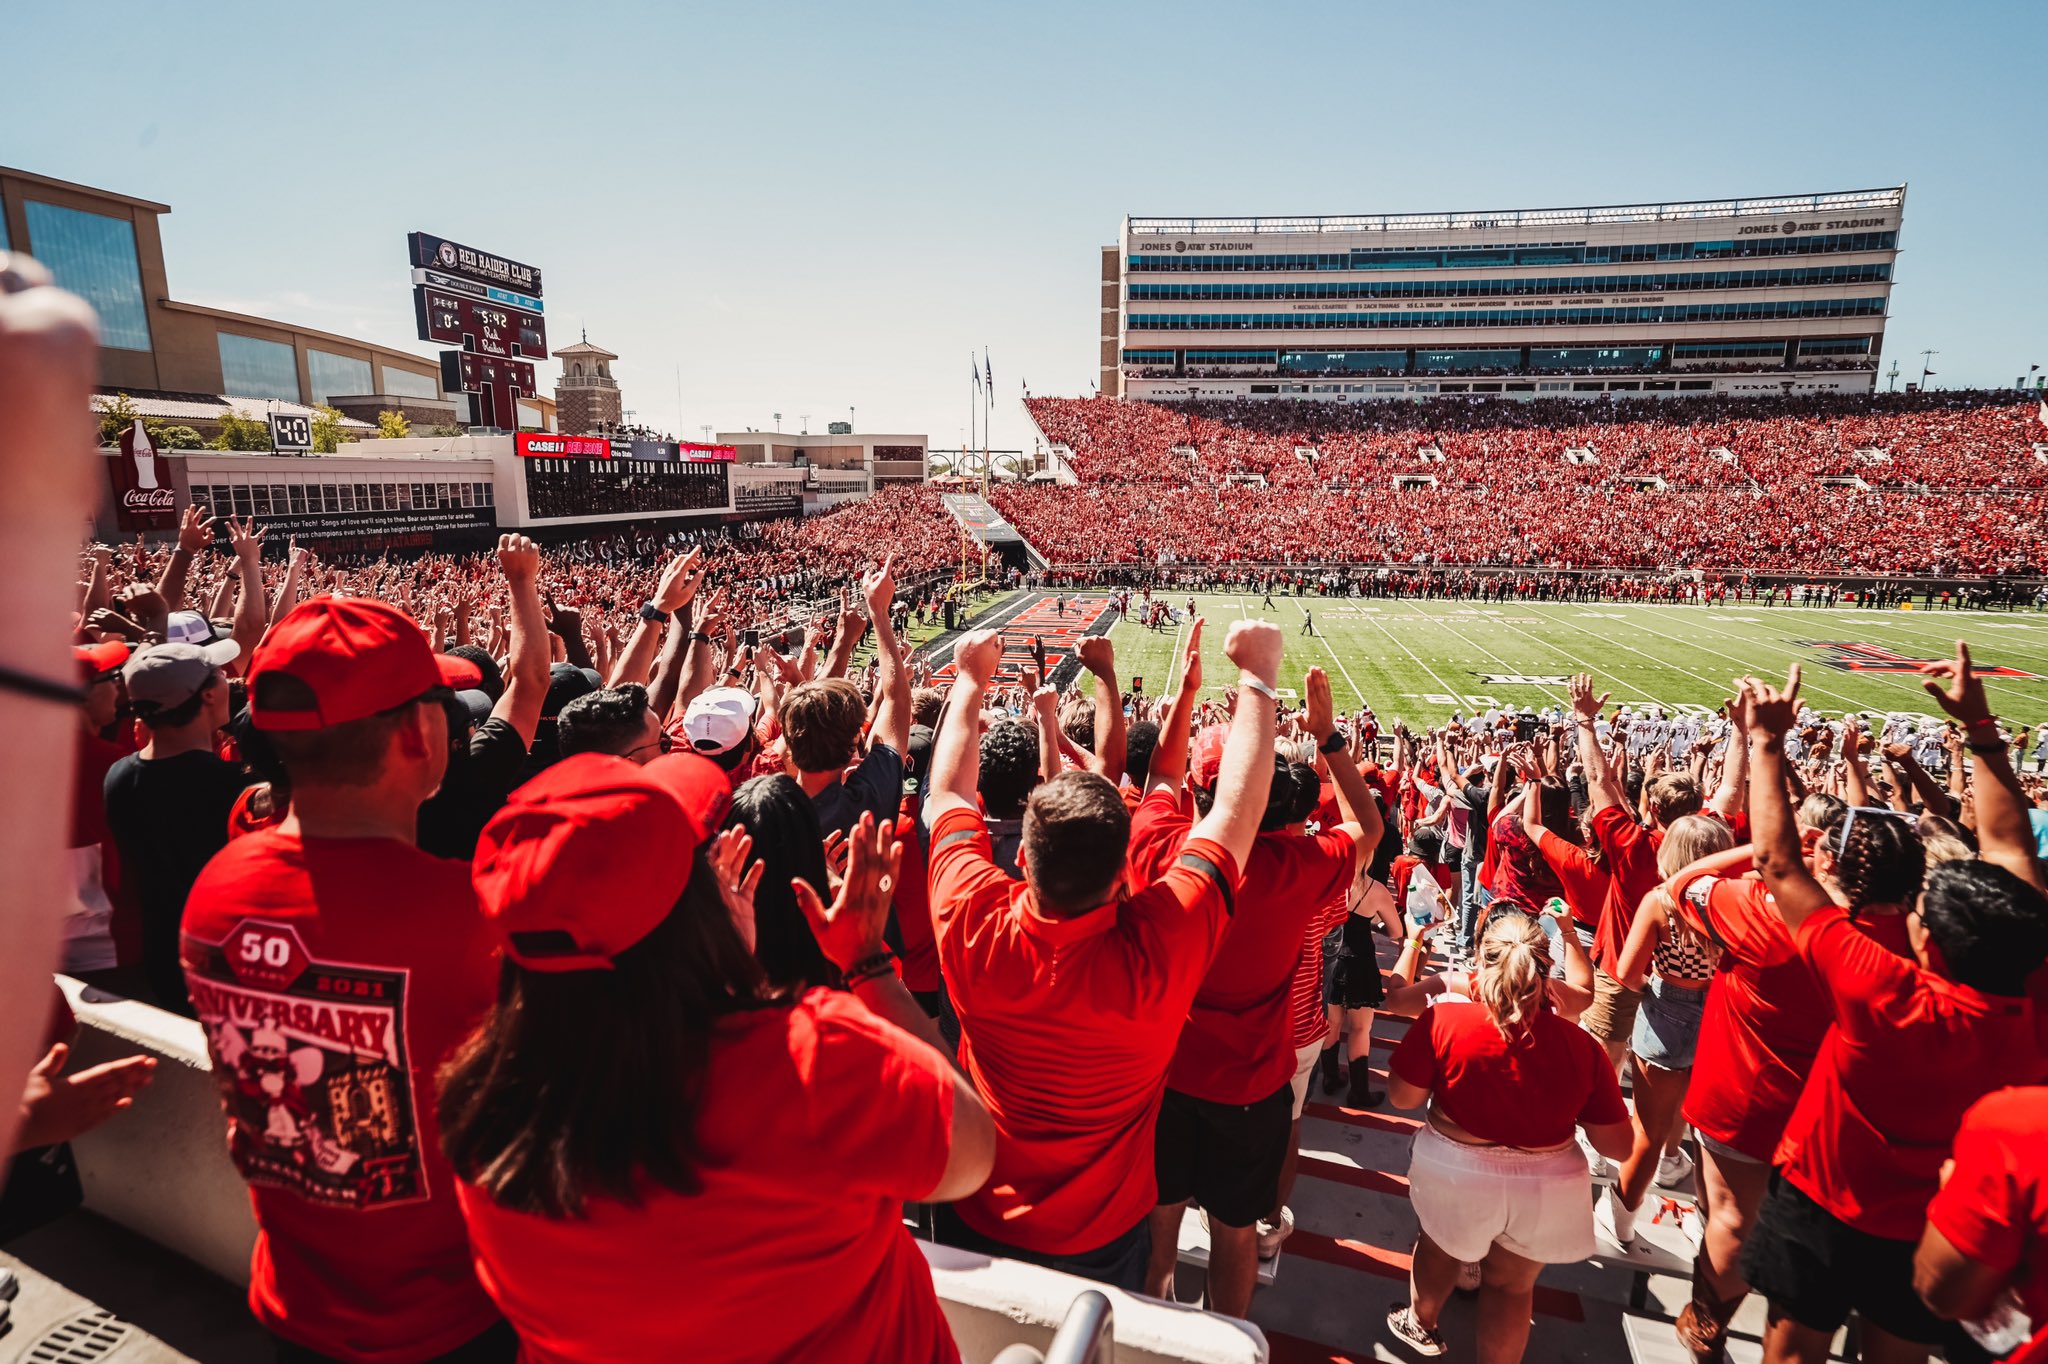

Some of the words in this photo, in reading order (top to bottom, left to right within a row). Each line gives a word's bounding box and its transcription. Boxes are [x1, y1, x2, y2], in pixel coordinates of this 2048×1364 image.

[1737, 225, 1778, 235] JONES
[1797, 222, 1823, 231] AT&T
[1826, 218, 1885, 230] STADIUM
[1140, 243, 1172, 251] JONES
[1187, 243, 1206, 251] AT&T
[1209, 243, 1253, 251] STADIUM
[458, 248, 477, 264] RED
[478, 254, 510, 276] RAIDER
[510, 265, 532, 282] CLUB
[450, 280, 469, 290] DOUBLE
[469, 284, 484, 293] EAGLE
[481, 311, 507, 328] 5:42
[483, 326, 501, 340] Red
[481, 339, 506, 355] Raiders
[465, 365, 471, 374] 4
[489, 368, 495, 378] 4
[276, 418, 308, 444] 40
[527, 440, 554, 452] CASE
[566, 441, 582, 454] RED
[582, 442, 604, 454] ZONE
[610, 441, 632, 449] Wisconsin
[610, 450, 621, 458] Ohio
[622, 450, 633, 458] State
[689, 449, 705, 459] CASE
[534, 458, 576, 473] GOIN'
[589, 461, 619, 474] BAND
[628, 461, 656, 474] FROM
[663, 462, 721, 475] RAIDERLAND
[123, 488, 175, 507] Coca-Cola
[321, 519, 340, 527] Songs
[340, 518, 347, 526] of
[375, 517, 387, 525] sing
[310, 530, 342, 538] champions
[390, 526, 410, 534] heights
[239, 933, 290, 967] 50
[316, 977, 385, 998] 2021
